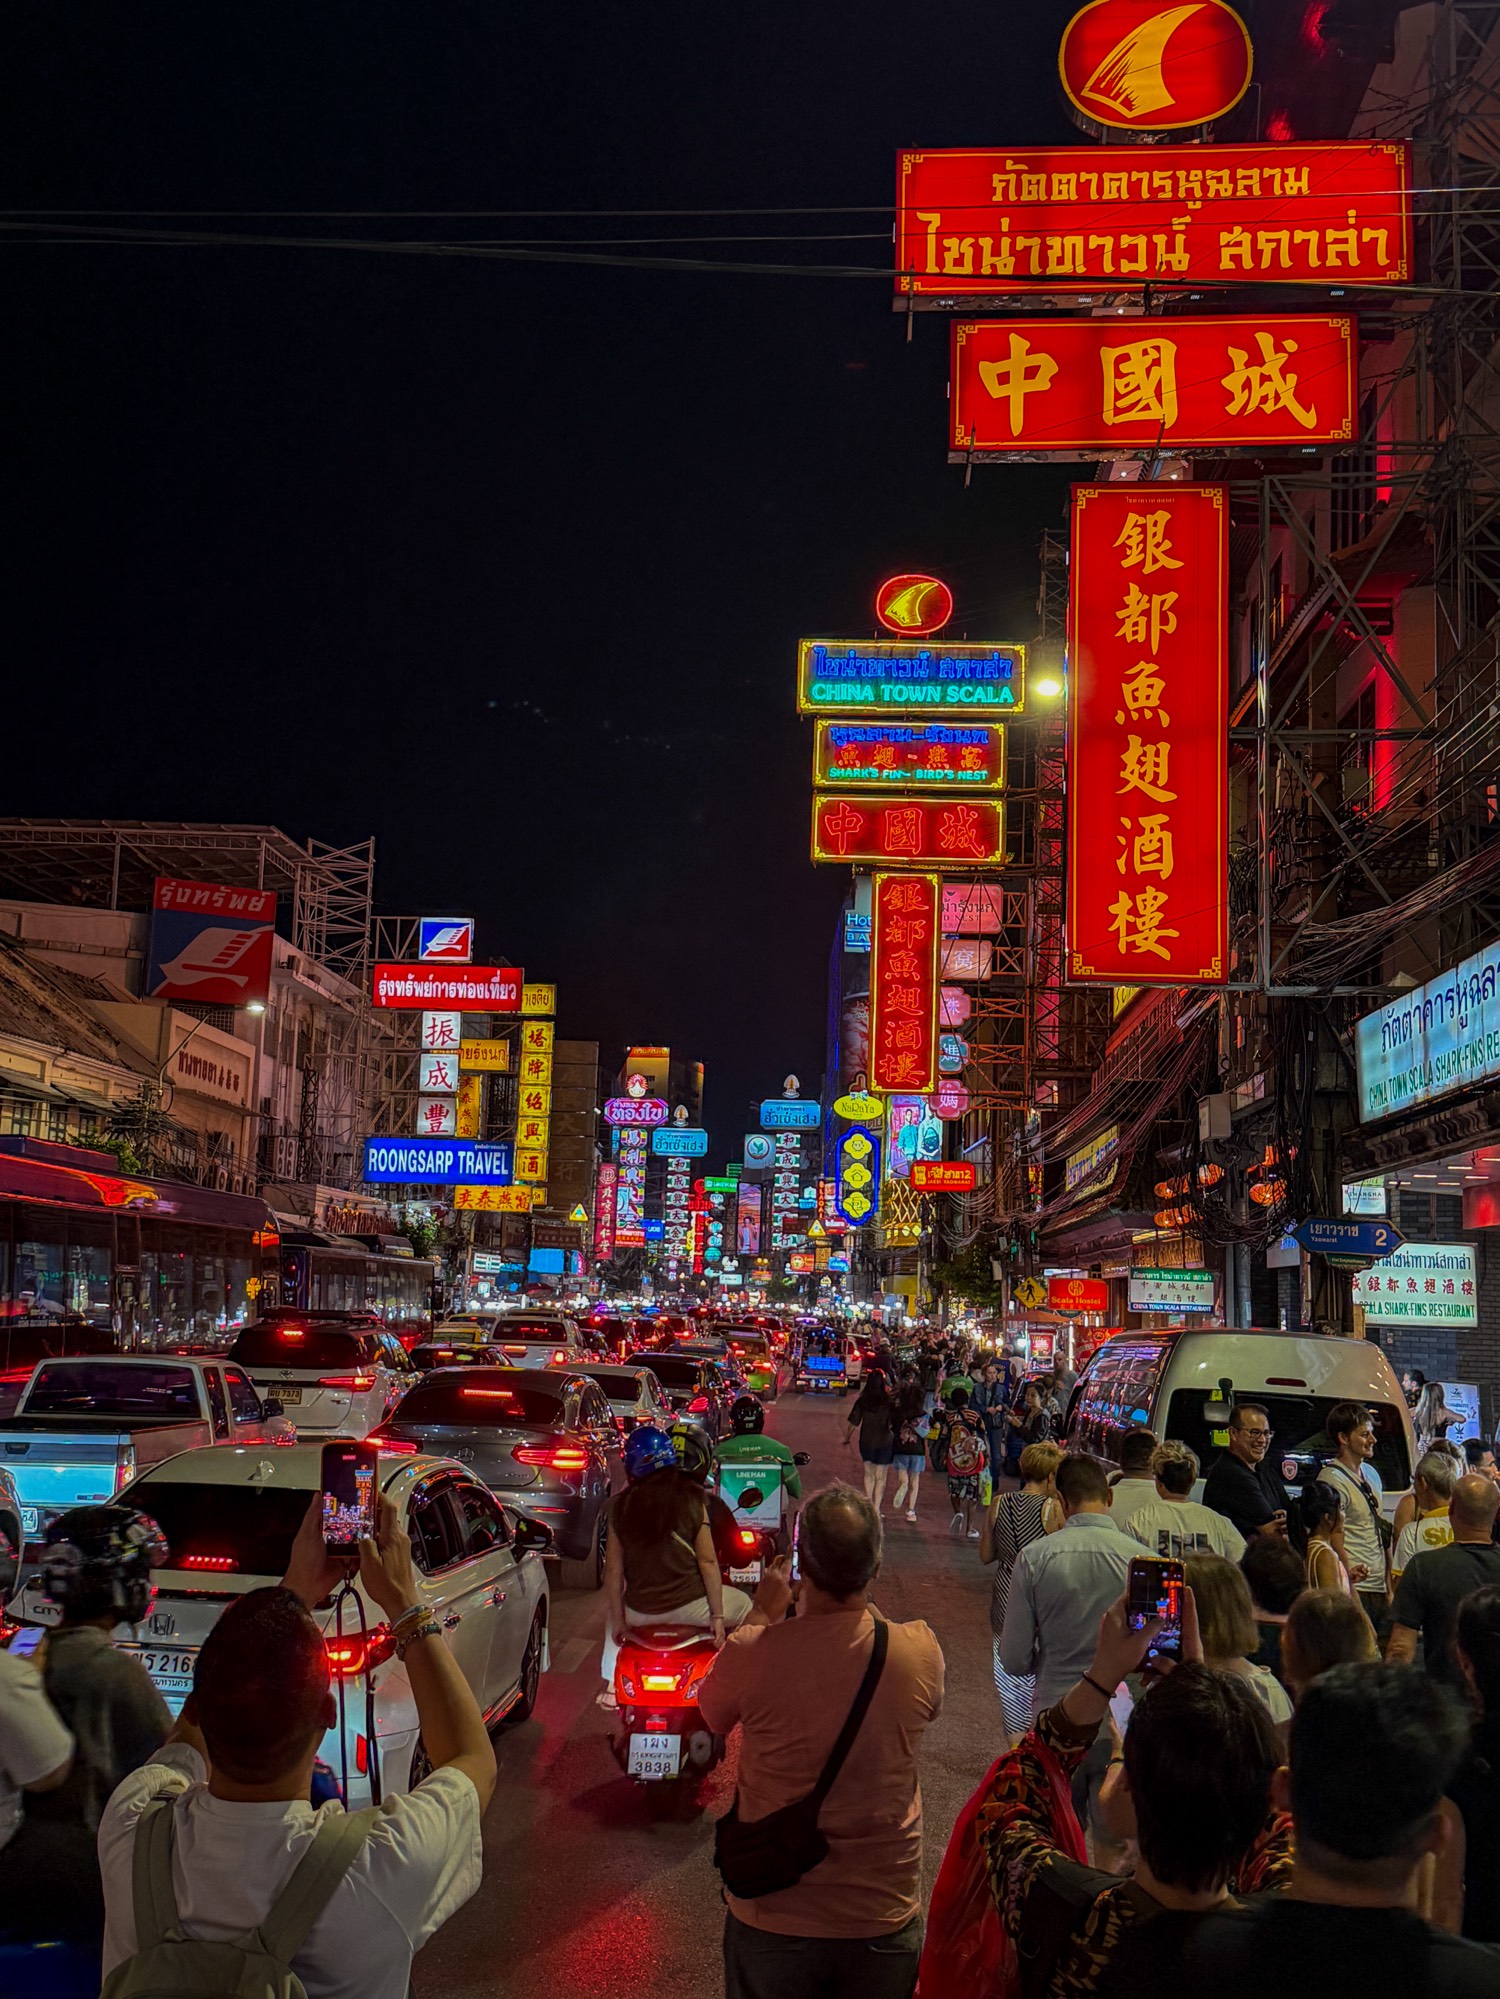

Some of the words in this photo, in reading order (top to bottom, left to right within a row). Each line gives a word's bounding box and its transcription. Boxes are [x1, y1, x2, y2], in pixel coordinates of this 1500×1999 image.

[992, 160, 1310, 209] ภัตตาคารหูฉลาม
[916, 212, 1192, 275] ไชน่าทาวน์
[1219, 210, 1391, 270] สกาล่า
[978, 332, 1318, 437] 中國城
[814, 647, 931, 678] ไชน่าทาวน์
[939, 652, 1013, 679] สกาล่า
[812, 683, 875, 701] CHINA
[881, 684, 941, 702] TOWN
[946, 685, 1014, 704] SCALA
[1107, 510, 1185, 961] 銀都魚翅酒樓
[829, 768, 879, 779] SHARK'S
[915, 769, 955, 780] BIRD'S
[958, 770, 988, 780] NEST
[824, 802, 985, 857] 中國城
[160, 881, 275, 912] รุ่งทรัพย์
[378, 970, 517, 1006] รุ่งทรัพย์การท่องเที่ยว
[879, 883, 930, 1085] 銀都魚翅酒樓
[424, 1017, 460, 1135] 振成豐
[1369, 1084, 1388, 1110] CHINA
[1389, 1071, 1408, 1101] TOWN
[1409, 1060, 1434, 1093] SCALA
[368, 1149, 454, 1174] ROONGSARP
[458, 1150, 509, 1175] TRAVEL
[1310, 1223, 1359, 1237] เยาวราช
[1375, 1229, 1387, 1246] 2
[1385, 1302, 1427, 1317] SHARK-FINS
[1429, 1304, 1475, 1318] RESTAURANT
[635, 1762, 671, 1772] 3838
